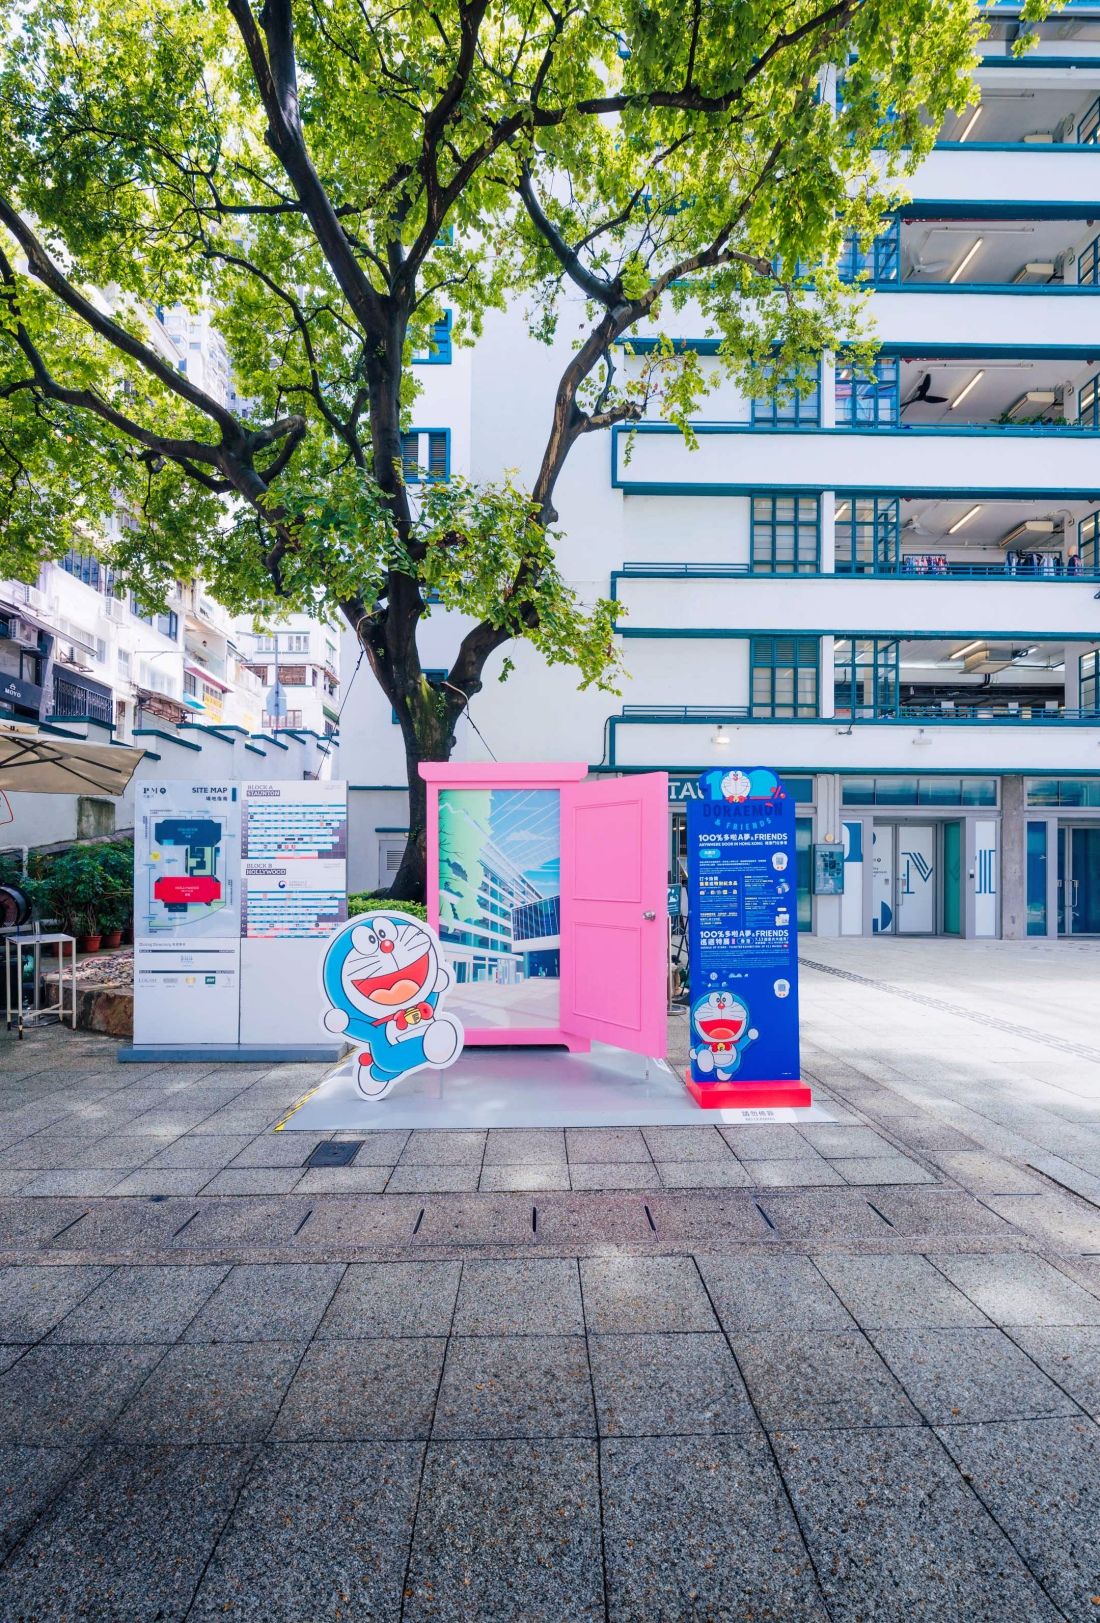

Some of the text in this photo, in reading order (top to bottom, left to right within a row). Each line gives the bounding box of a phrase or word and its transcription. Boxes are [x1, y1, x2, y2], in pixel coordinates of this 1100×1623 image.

[4, 688, 21, 697] MOYO
[703, 802, 783, 817] DORAEMON
[726, 817, 772, 831] FRIENDS
